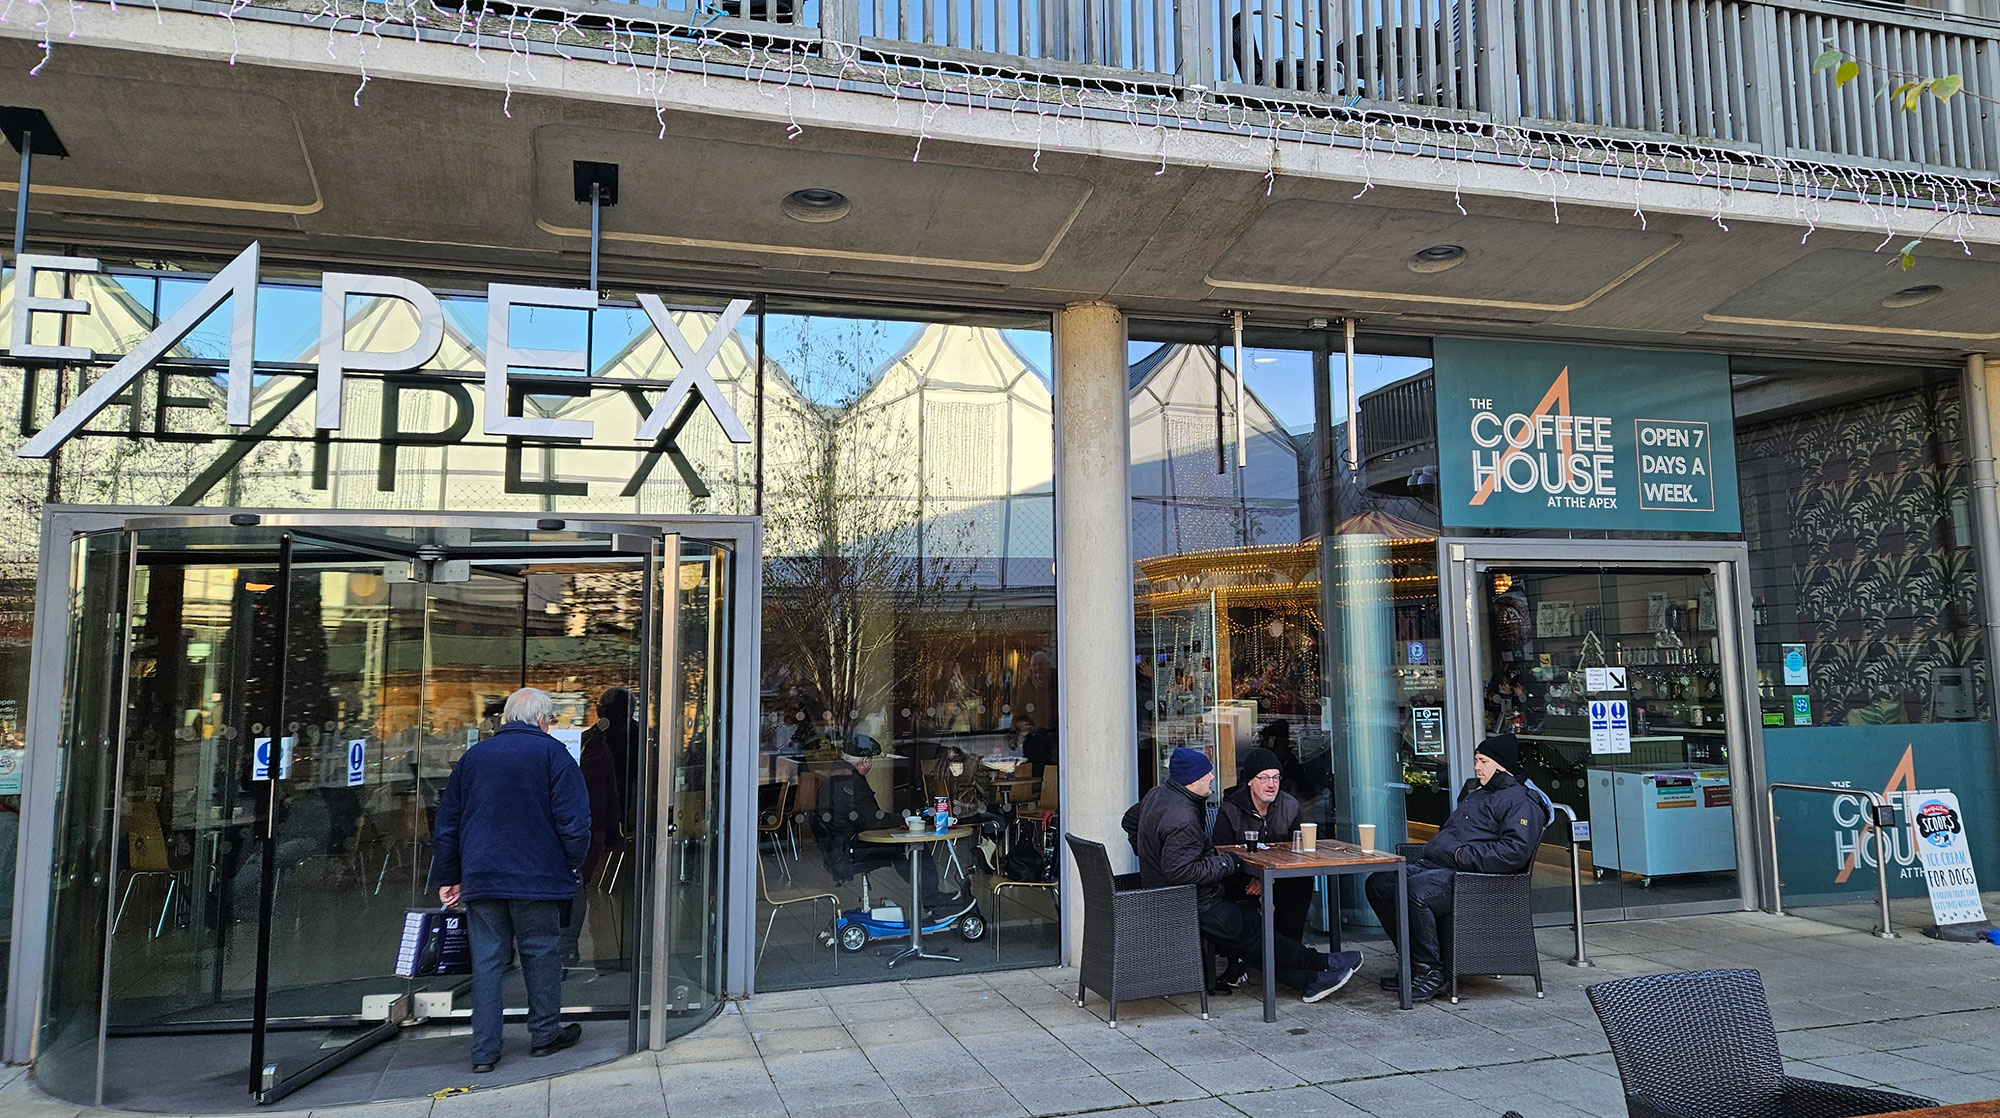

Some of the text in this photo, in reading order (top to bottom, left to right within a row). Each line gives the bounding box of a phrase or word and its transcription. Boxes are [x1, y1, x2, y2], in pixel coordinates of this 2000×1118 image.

[15, 240, 753, 459] APEX
[1469, 397, 1493, 410] THE
[1470, 411, 1614, 452] COFFEE
[1640, 427, 1704, 448] OPEN 7
[1472, 449, 1617, 496] HOUSE
[1642, 455, 1706, 476] DAYS A
[1547, 496, 1617, 509] AT THE APEX
[1644, 482, 1698, 503] WEEK.
[1835, 827, 1922, 871] HOU
[1927, 850, 1967, 867] ICE CREAM
[1900, 867, 1926, 878] AT TH
[1928, 867, 1975, 888] FOR DOGS
